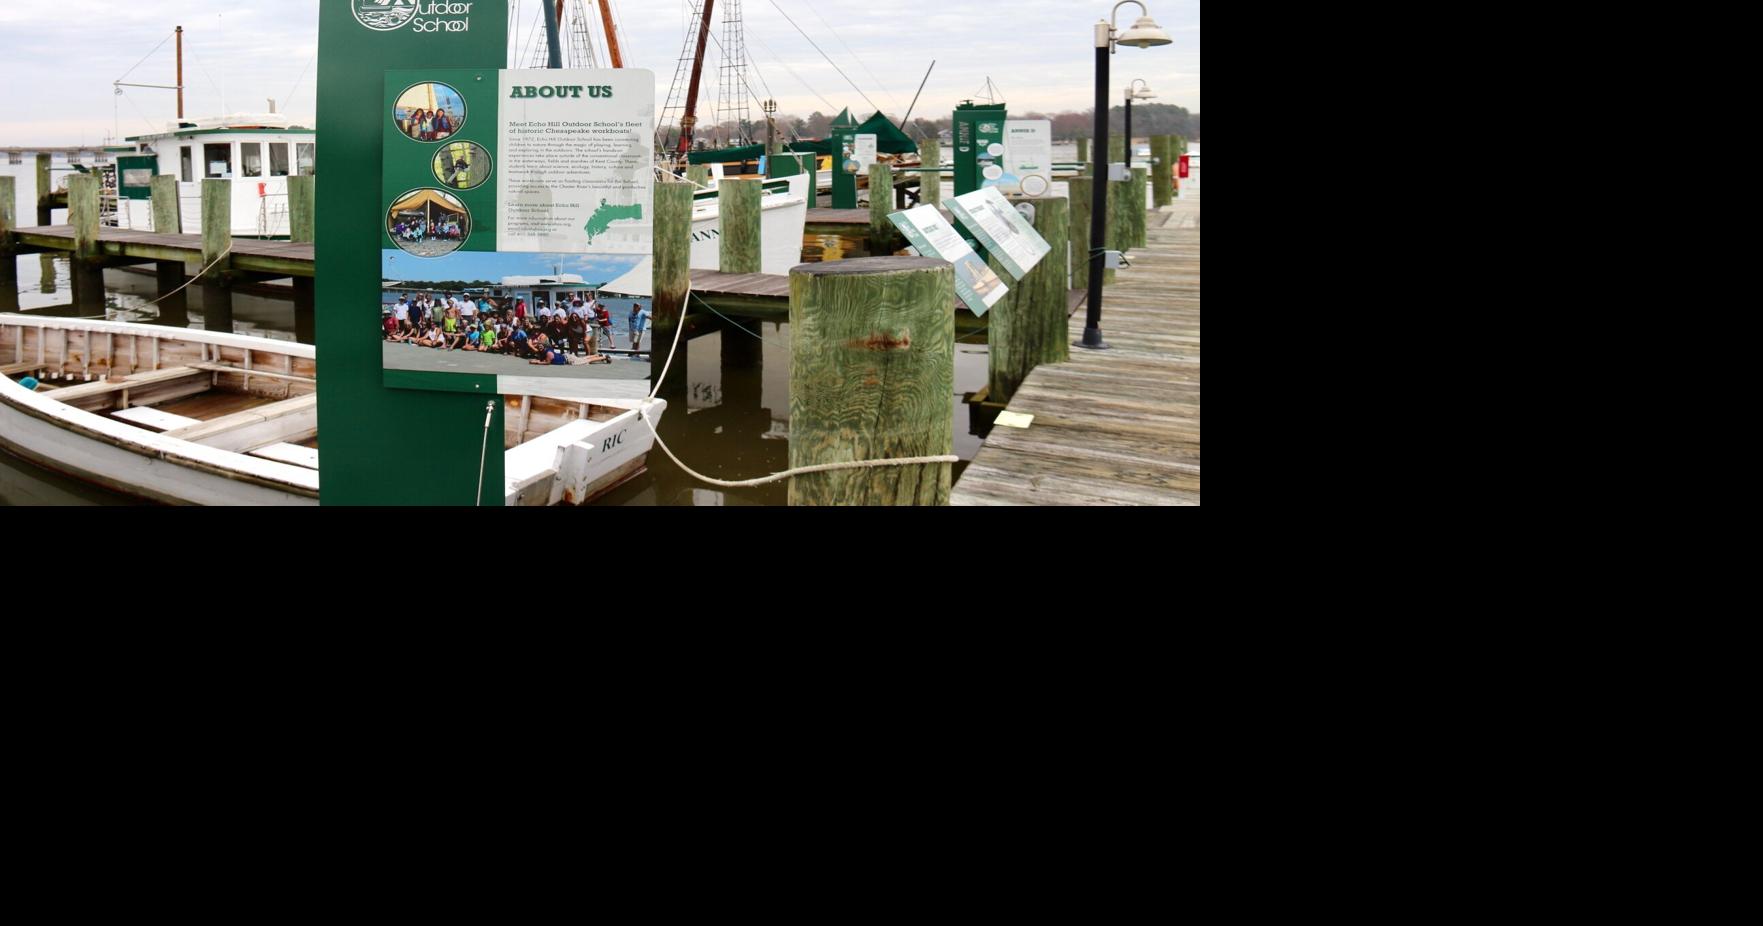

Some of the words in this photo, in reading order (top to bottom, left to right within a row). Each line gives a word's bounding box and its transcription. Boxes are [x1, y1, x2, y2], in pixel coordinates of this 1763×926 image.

[412, 17, 470, 32] School
[510, 85, 583, 98] ABOUT
[587, 85, 613, 98] US
[602, 429, 627, 452] RIC
